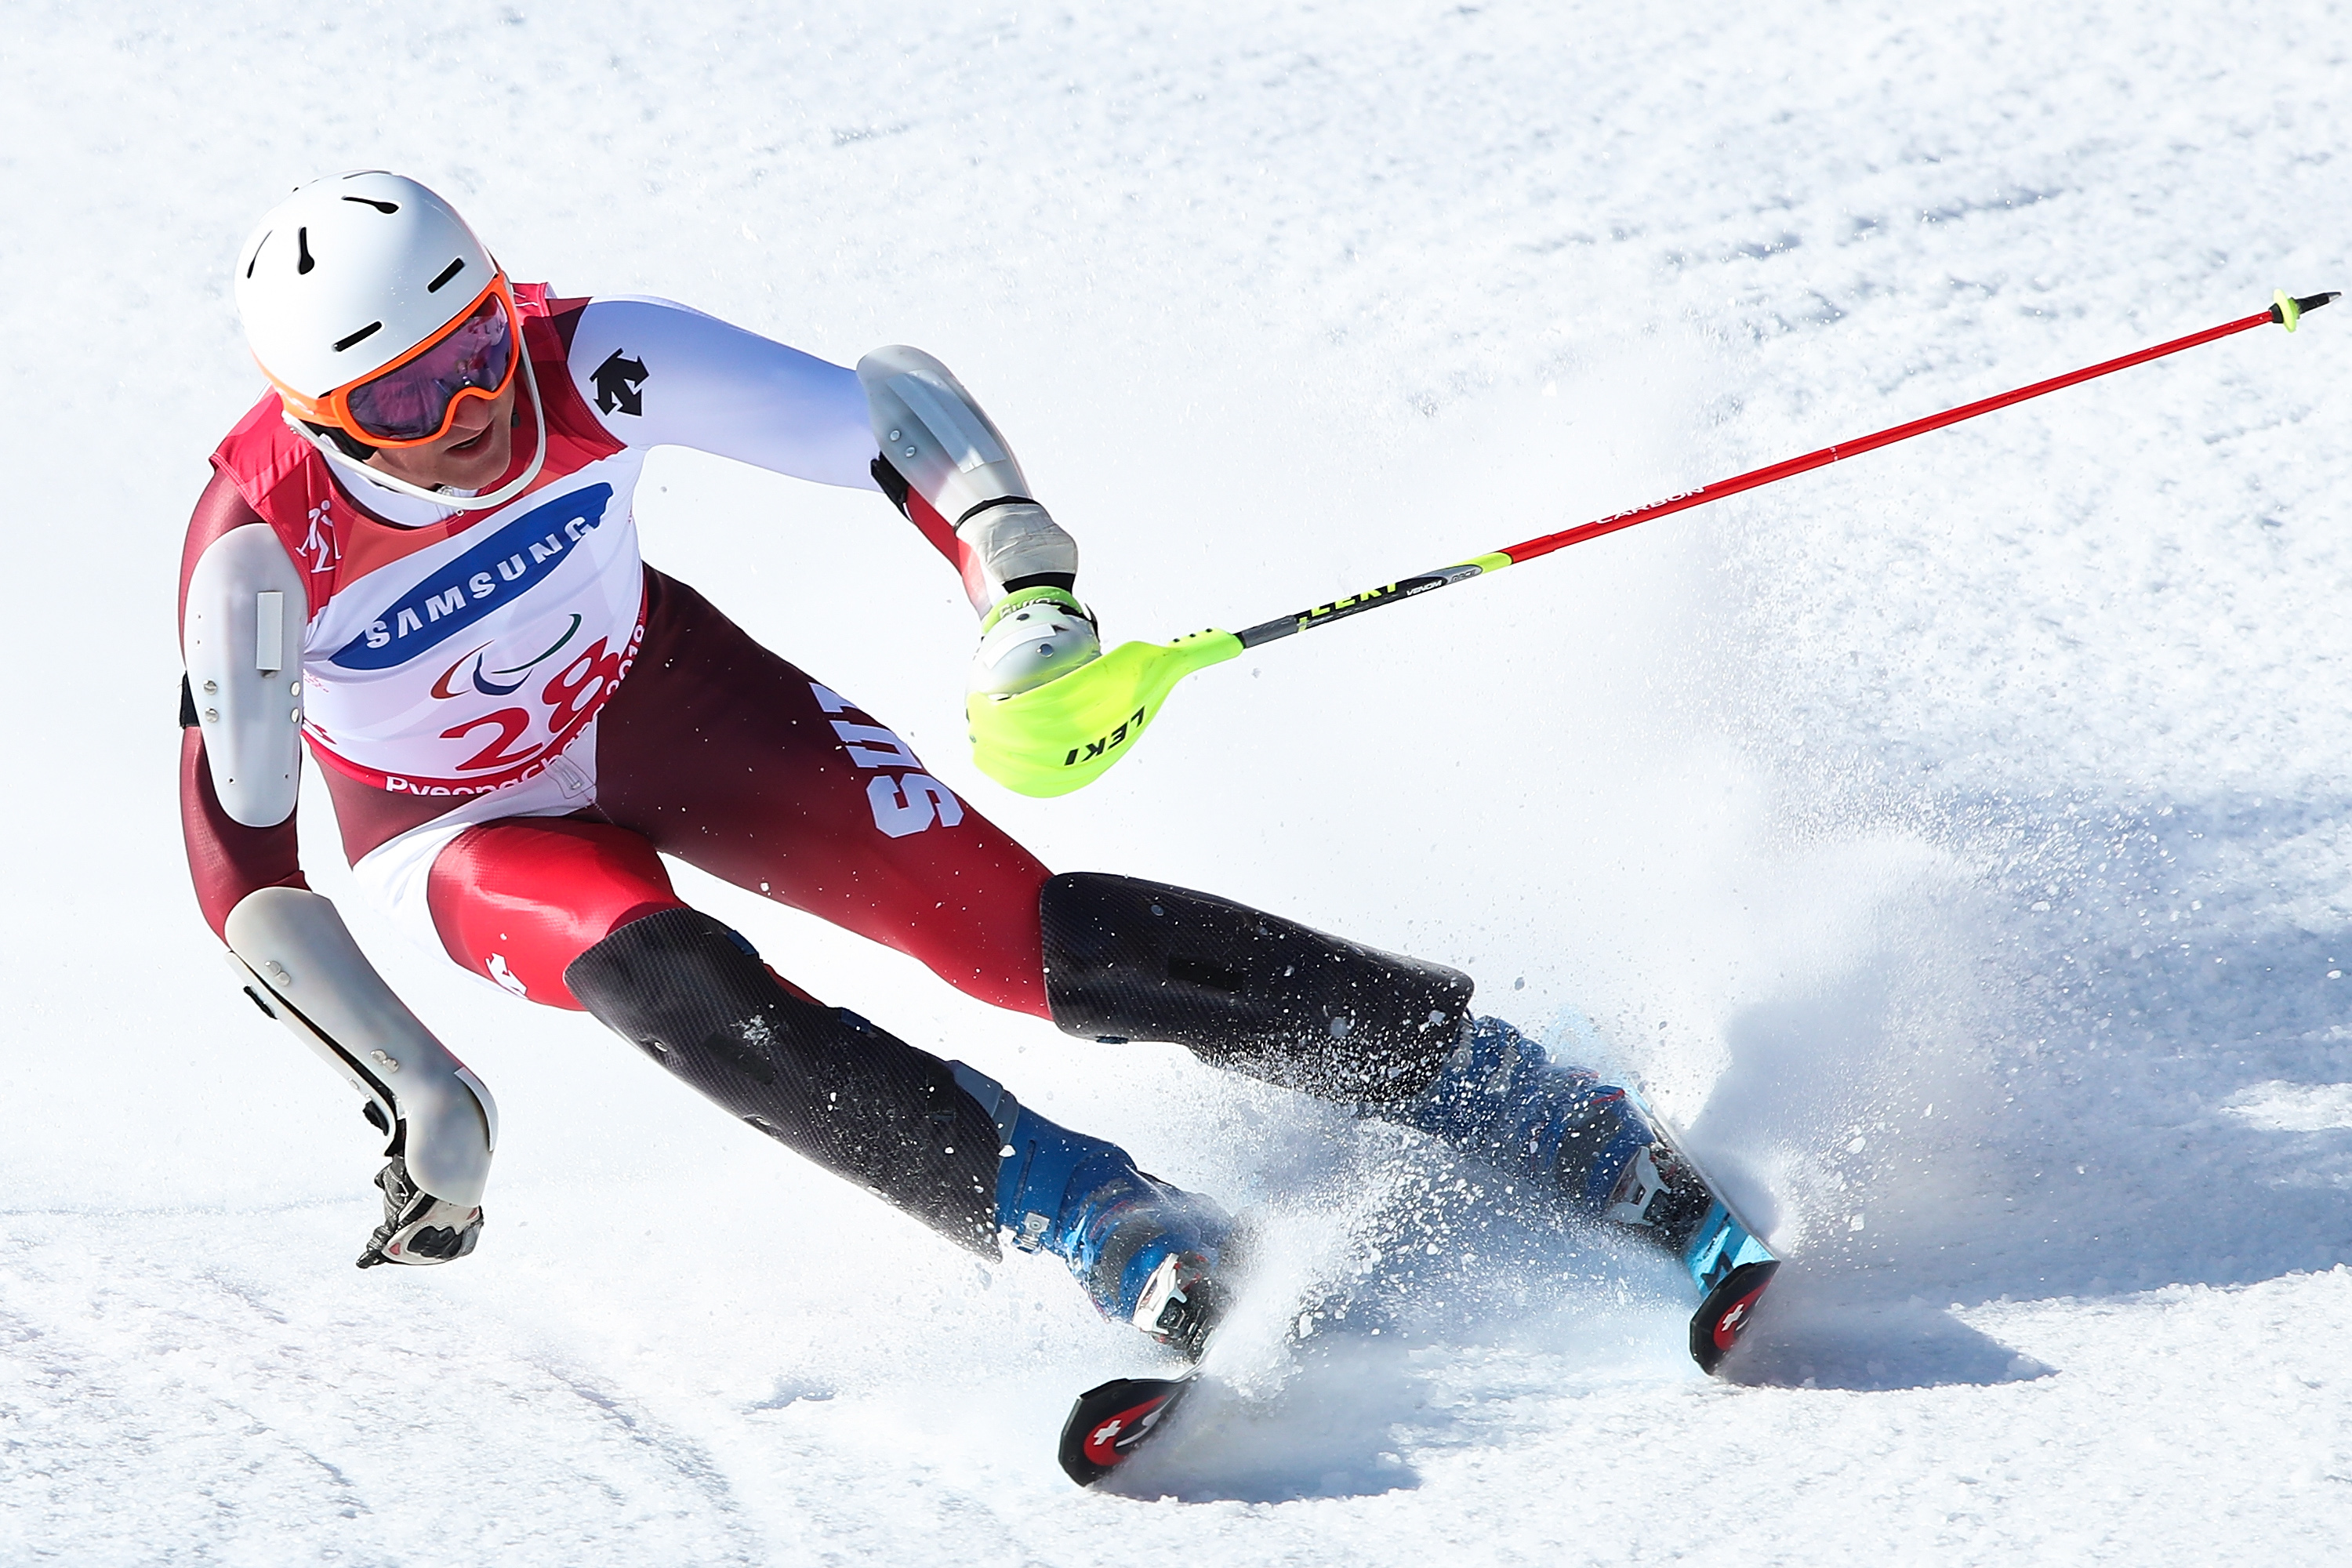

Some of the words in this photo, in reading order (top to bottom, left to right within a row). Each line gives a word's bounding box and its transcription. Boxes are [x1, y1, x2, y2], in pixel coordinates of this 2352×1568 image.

[1595, 486, 1705, 524] CARBON
[365, 515, 591, 649] SAMSUNG
[1406, 579, 1443, 596] VENOM
[437, 634, 621, 771] 28
[1064, 705, 1145, 767] LEKI
